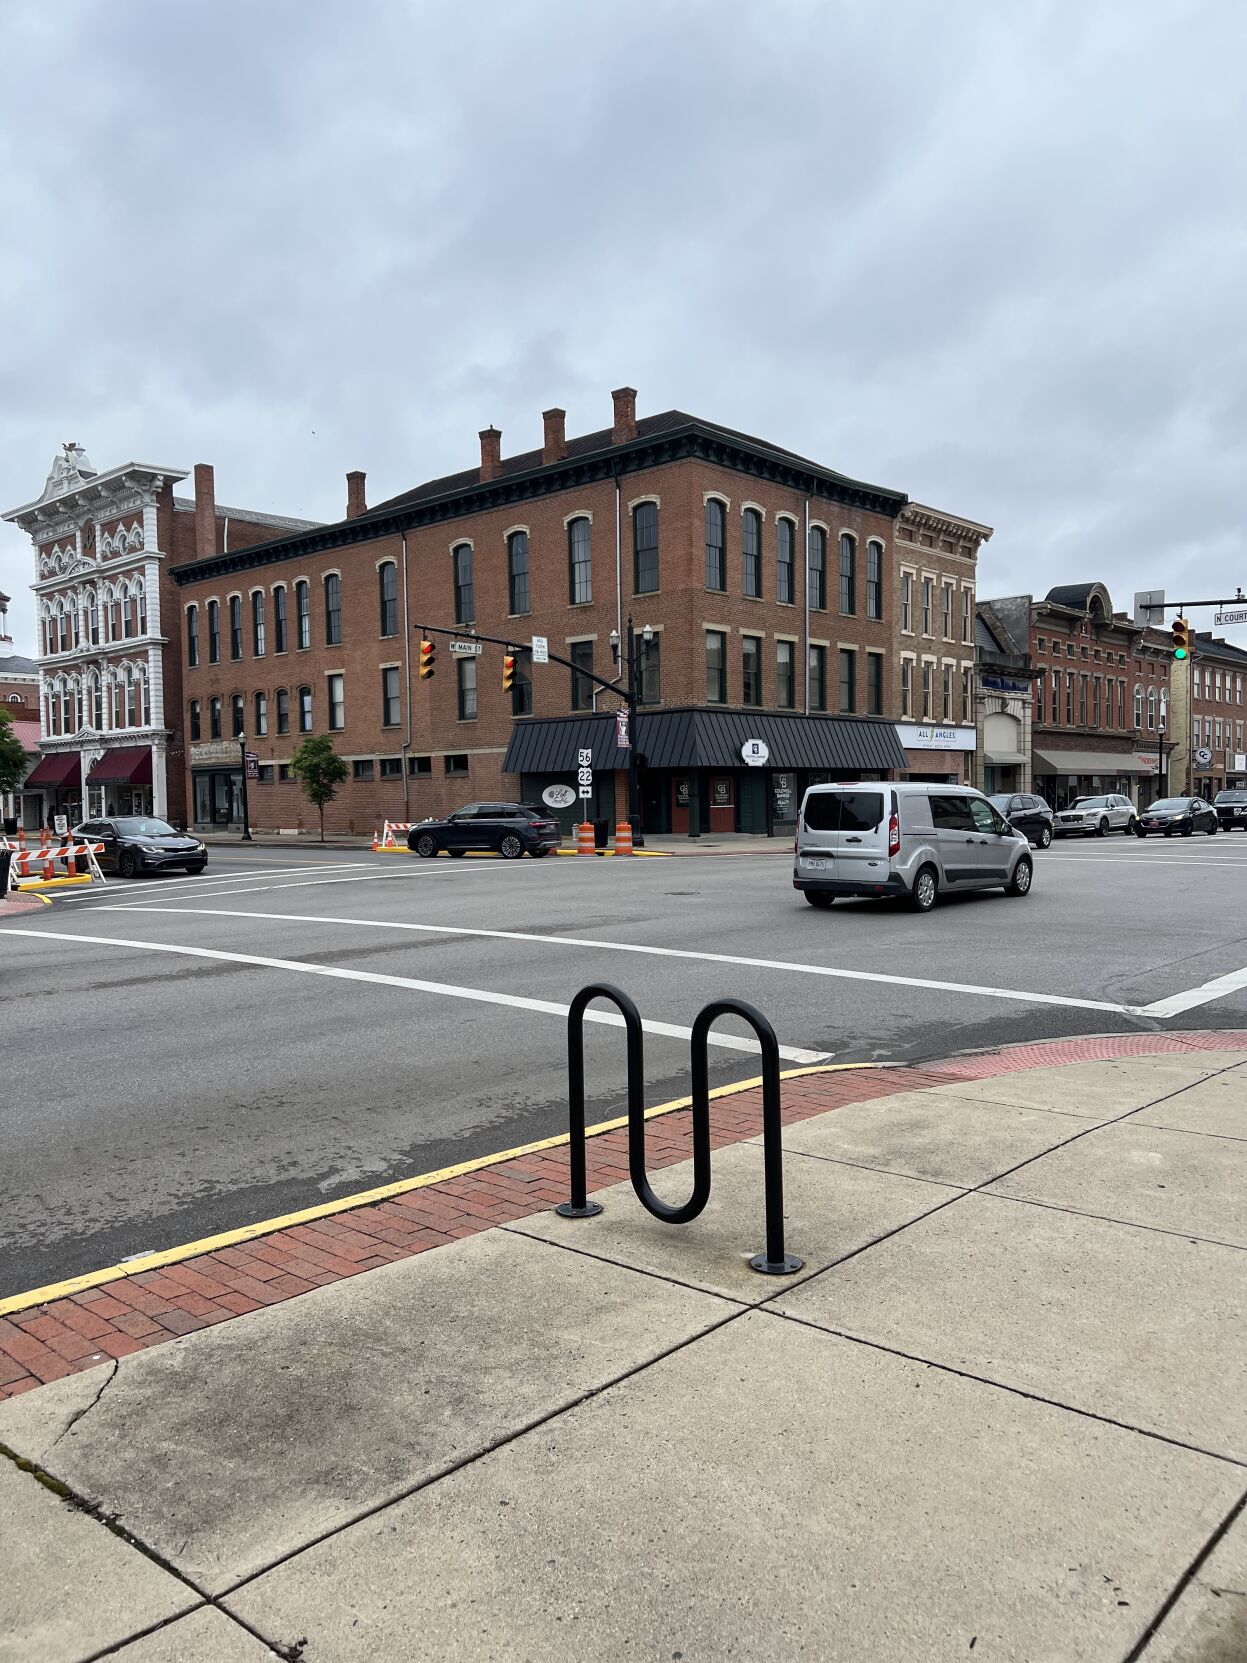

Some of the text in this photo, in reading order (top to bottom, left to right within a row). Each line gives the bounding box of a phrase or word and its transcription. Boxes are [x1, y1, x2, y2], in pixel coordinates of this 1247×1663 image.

[1225, 612, 1247, 622] COURT
[474, 645, 481, 653] ST
[919, 730, 956, 740] ALL ANGLES
[579, 751, 591, 762] 56
[579, 770, 591, 781] 22
